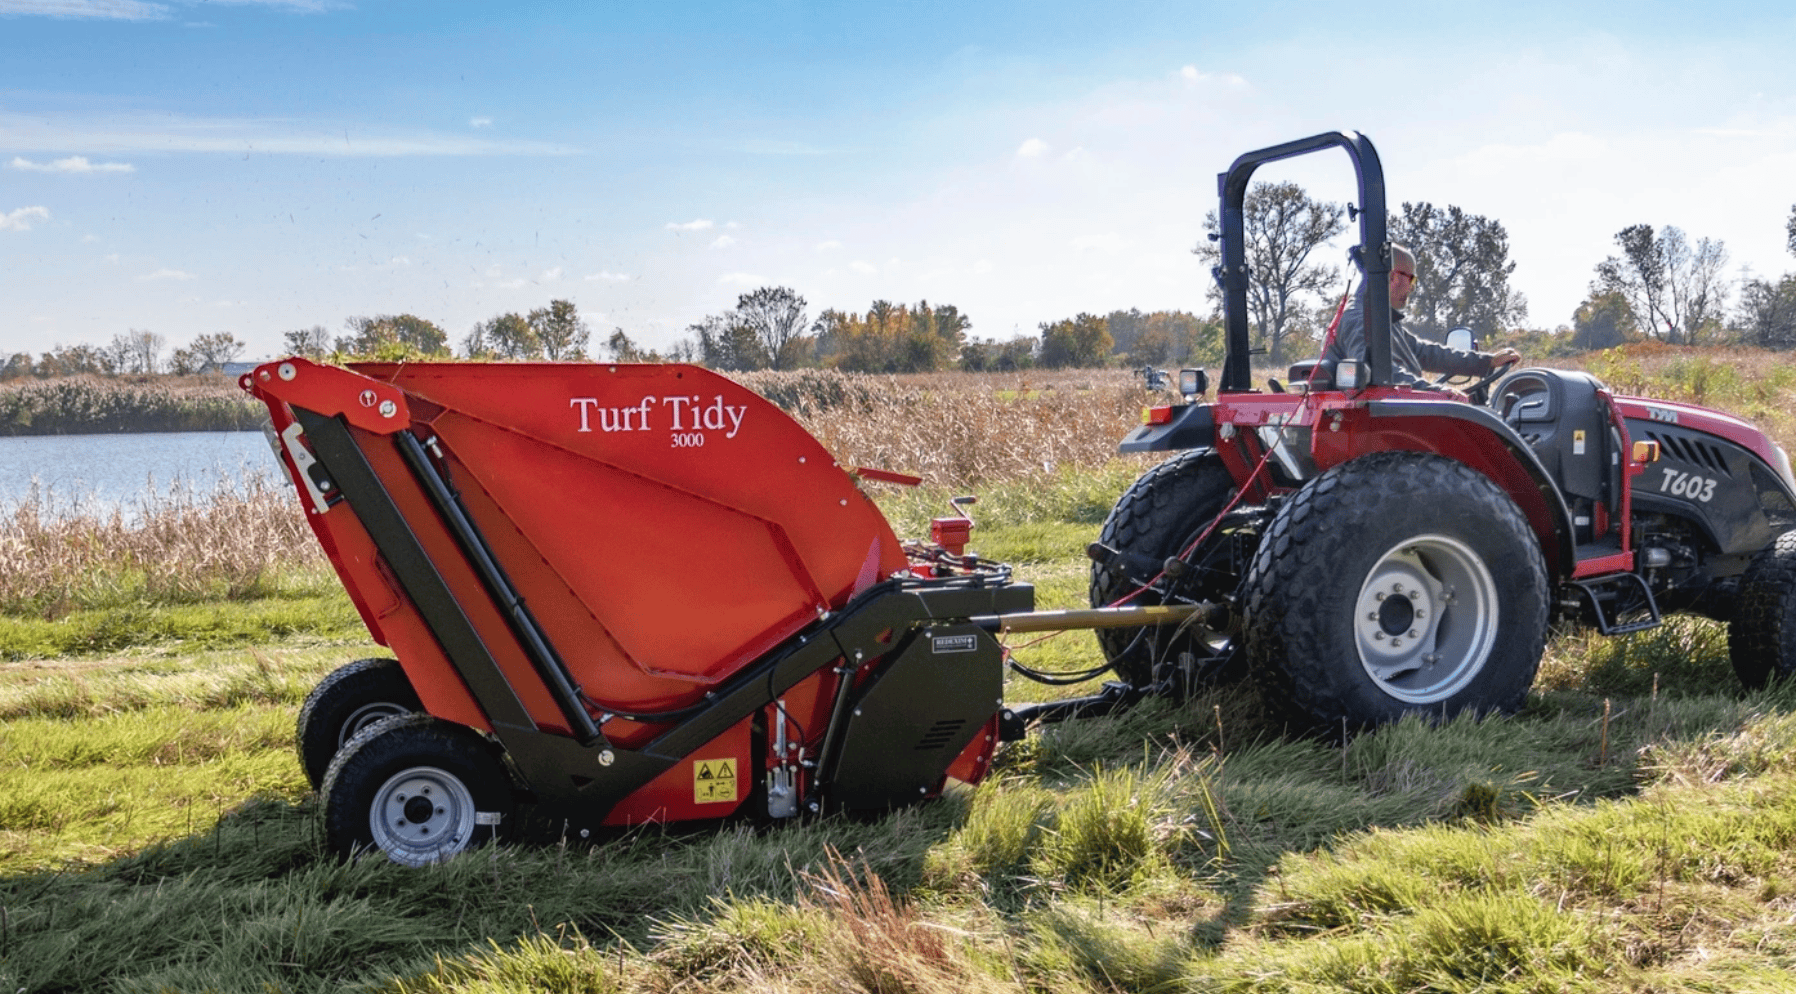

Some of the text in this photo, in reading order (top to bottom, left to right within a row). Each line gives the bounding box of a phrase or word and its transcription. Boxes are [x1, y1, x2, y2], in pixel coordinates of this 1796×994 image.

[570, 395, 748, 438] Turf Tidy
[670, 433, 704, 447] 3000
[1660, 468, 1717, 502] T603
